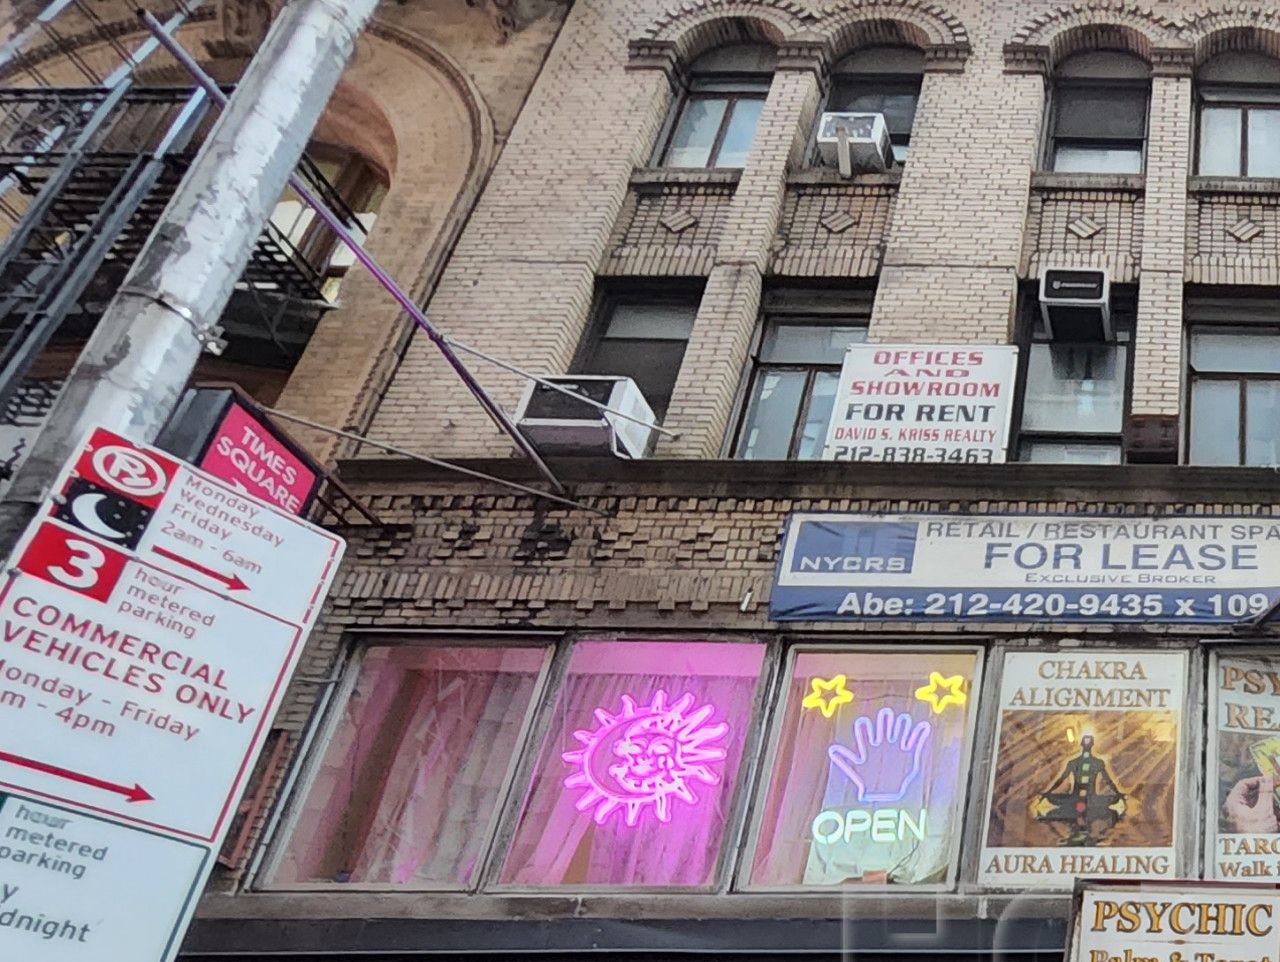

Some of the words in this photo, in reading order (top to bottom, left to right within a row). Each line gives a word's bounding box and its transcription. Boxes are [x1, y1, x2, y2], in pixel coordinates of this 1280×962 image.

[873, 350, 984, 366] OFFICES
[884, 368, 970, 378] AND
[851, 380, 1001, 398] SHOWROOM
[845, 403, 906, 421] FOR
[915, 404, 996, 423] RENT
[834, 427, 877, 440] DAVID
[880, 427, 893, 441] S.
[899, 428, 940, 442] KRISS
[944, 429, 998, 443] REALTY
[242, 425, 298, 485] TIMES
[833, 446, 994, 464] 212-838-3463
[216, 435, 300, 514] SQUARE
[185, 475, 260, 519] Monday
[171, 503, 232, 540] Friday
[180, 488, 286, 548] Wednesday
[926, 522, 1020, 538] RETAIL
[1044, 522, 1223, 541] RESTAURANT
[160, 521, 204, 549] 2am
[222, 549, 262, 574] 6am
[984, 542, 1083, 570] FOR
[1101, 543, 1259, 571] LEASE
[46, 538, 105, 590] 3
[135, 567, 184, 595] hour
[117, 600, 197, 640] parking
[126, 584, 215, 628] metered
[837, 592, 913, 616] Abe:
[924, 592, 1163, 617] 212-420-9435
[1175, 599, 1195, 616] x
[1209, 592, 1269, 617] 109
[12, 595, 229, 691] COMMERCIAL
[2, 619, 166, 695] VEHICLES
[175, 682, 257, 726] ONLY
[1038, 660, 1148, 680] CHAKRA
[0, 659, 92, 706] onday
[120, 702, 200, 741] Friday
[1009, 687, 1171, 707] ALIGNMENT
[55, 706, 116, 737] 4pm
[15, 804, 73, 829] hour
[811, 808, 930, 844] OPEN
[5, 825, 109, 861] metered
[985, 855, 1054, 874] AURA
[1058, 855, 1170, 875] HEALING
[1218, 861, 1273, 877] Walk
[1091, 901, 1273, 937] PSYCHIC
